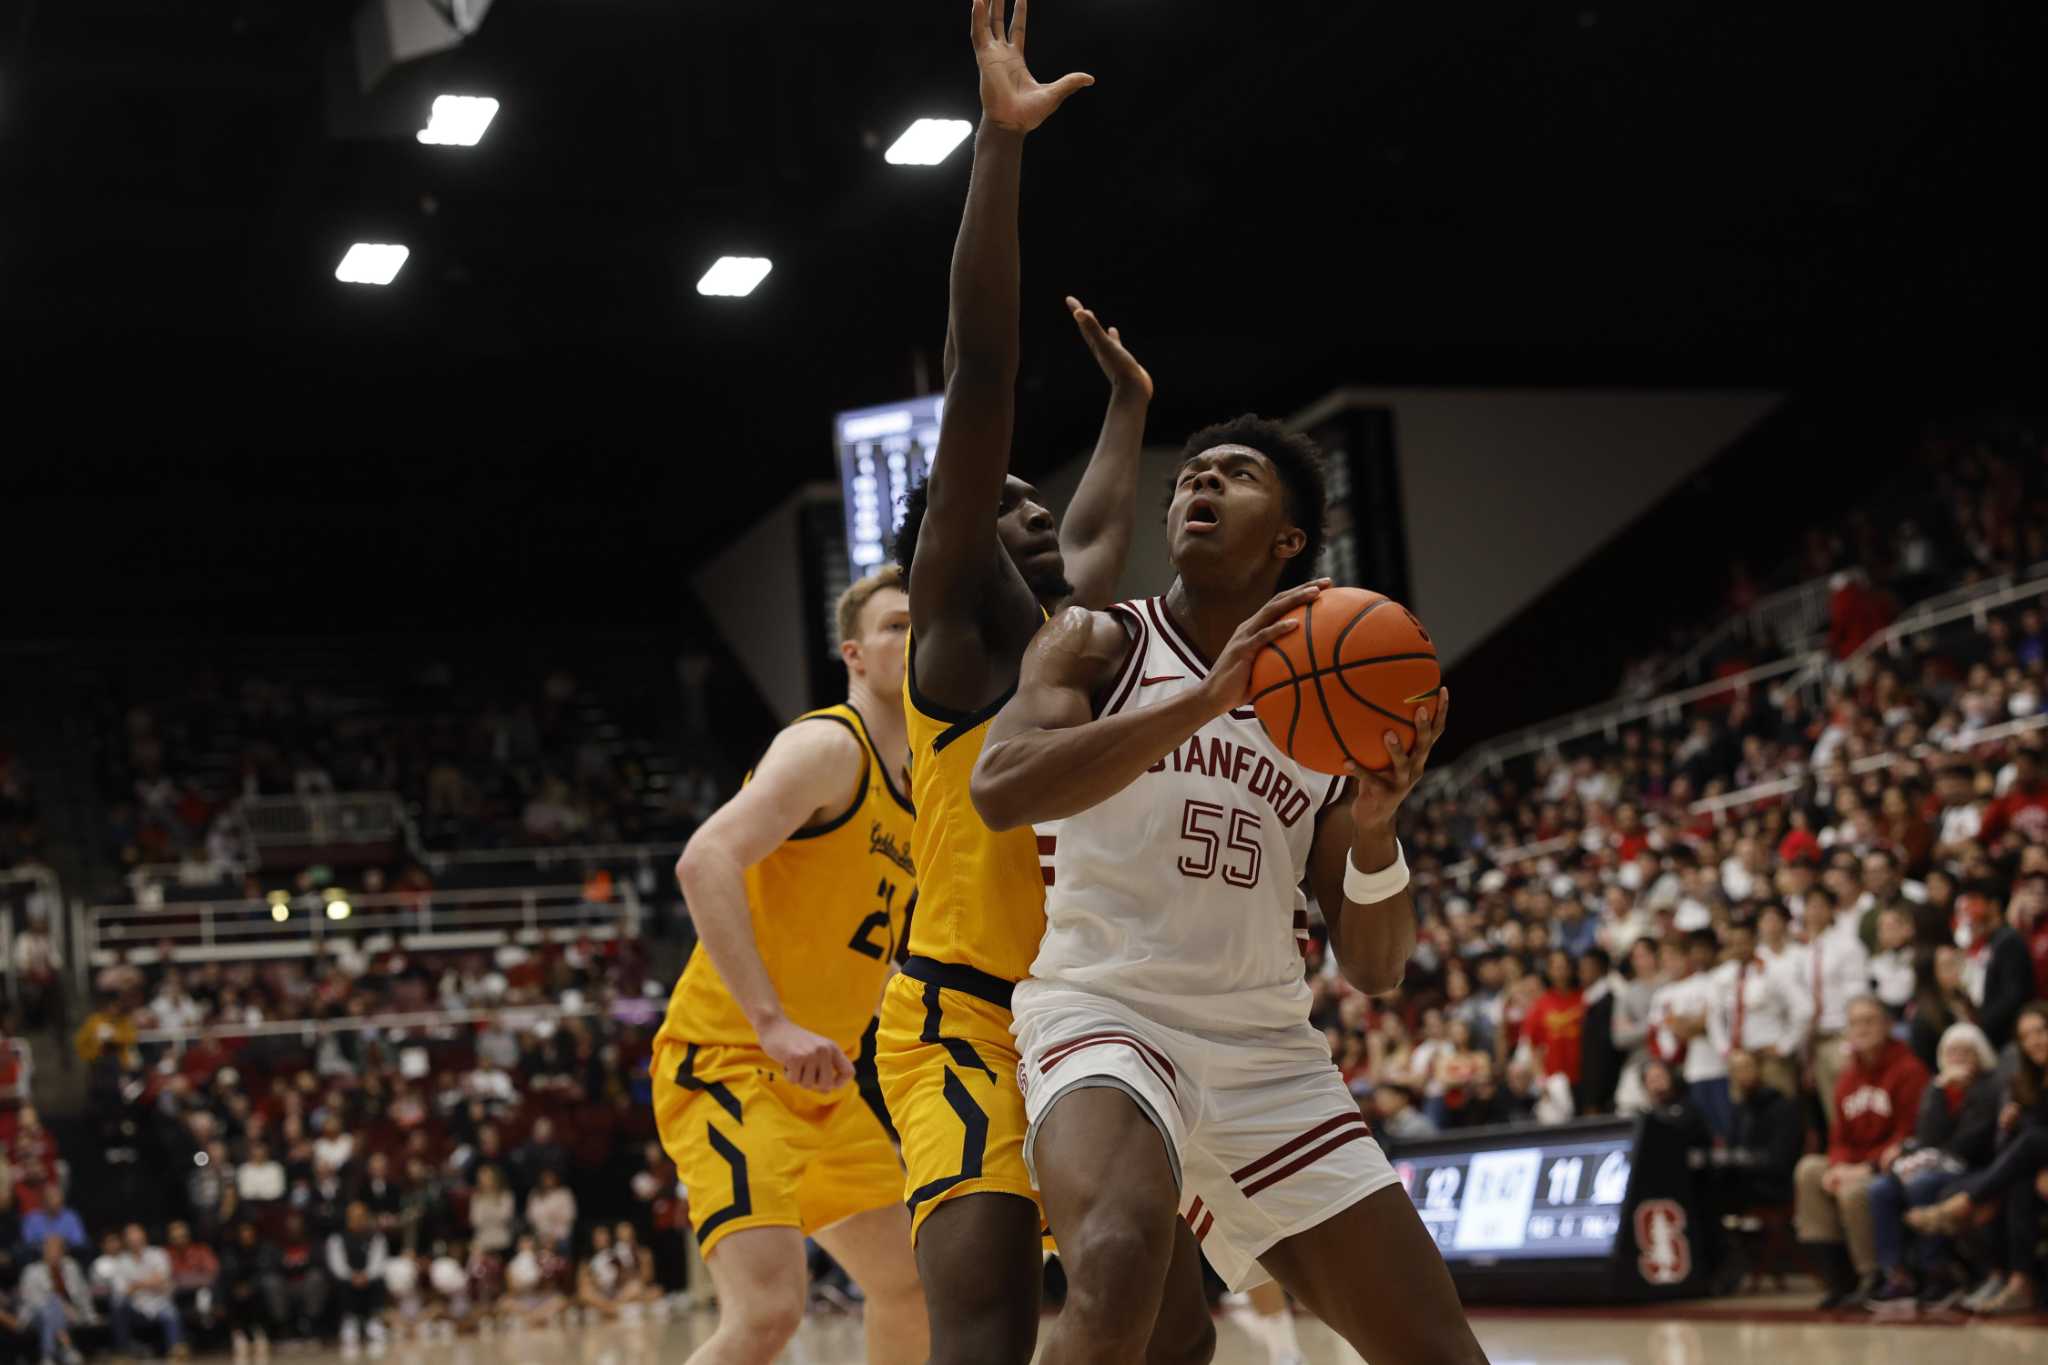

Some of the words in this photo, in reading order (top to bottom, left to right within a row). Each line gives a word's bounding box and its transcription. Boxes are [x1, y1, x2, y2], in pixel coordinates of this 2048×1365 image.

[1178, 799, 1262, 890] 55
[1425, 1166, 1461, 1211] 12
[1547, 1156, 1584, 1206] 11
